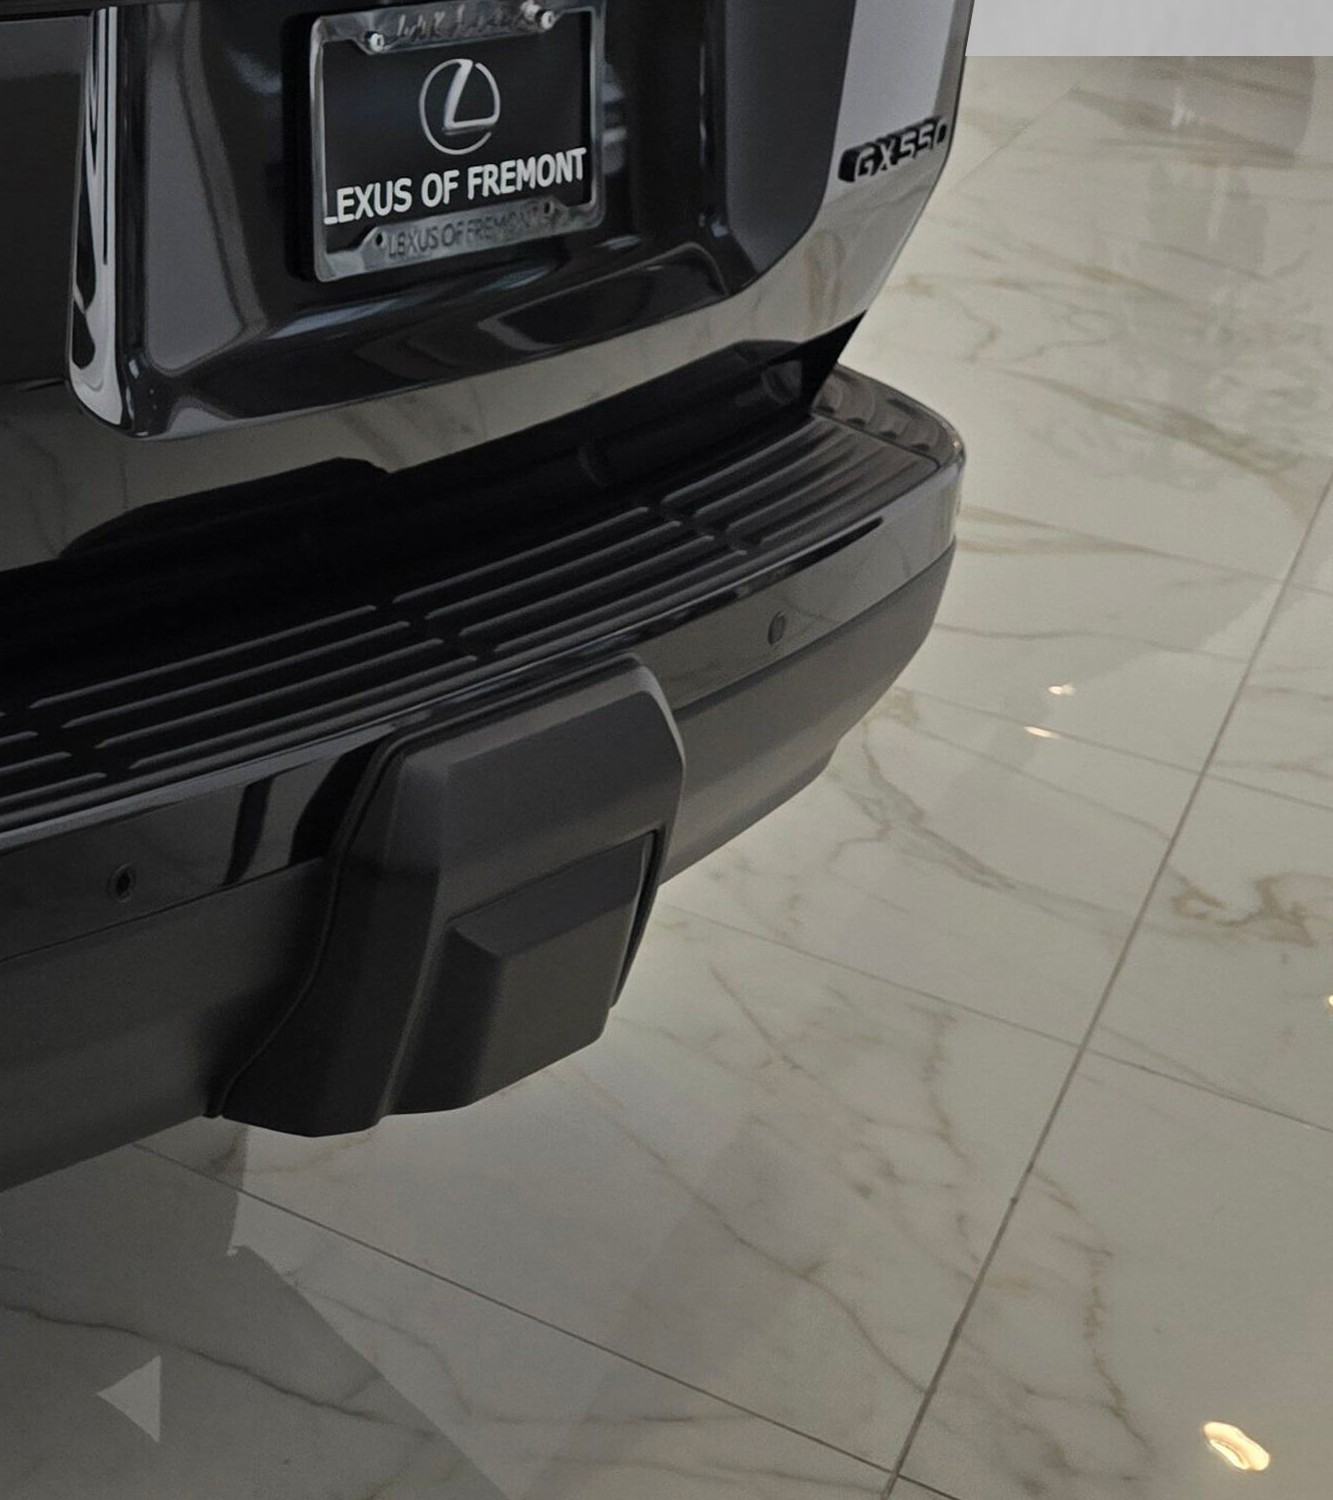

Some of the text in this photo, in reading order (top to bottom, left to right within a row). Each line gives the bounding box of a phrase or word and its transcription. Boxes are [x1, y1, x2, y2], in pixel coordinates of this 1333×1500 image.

[324, 148, 587, 224] EXUS OF FREMONT
